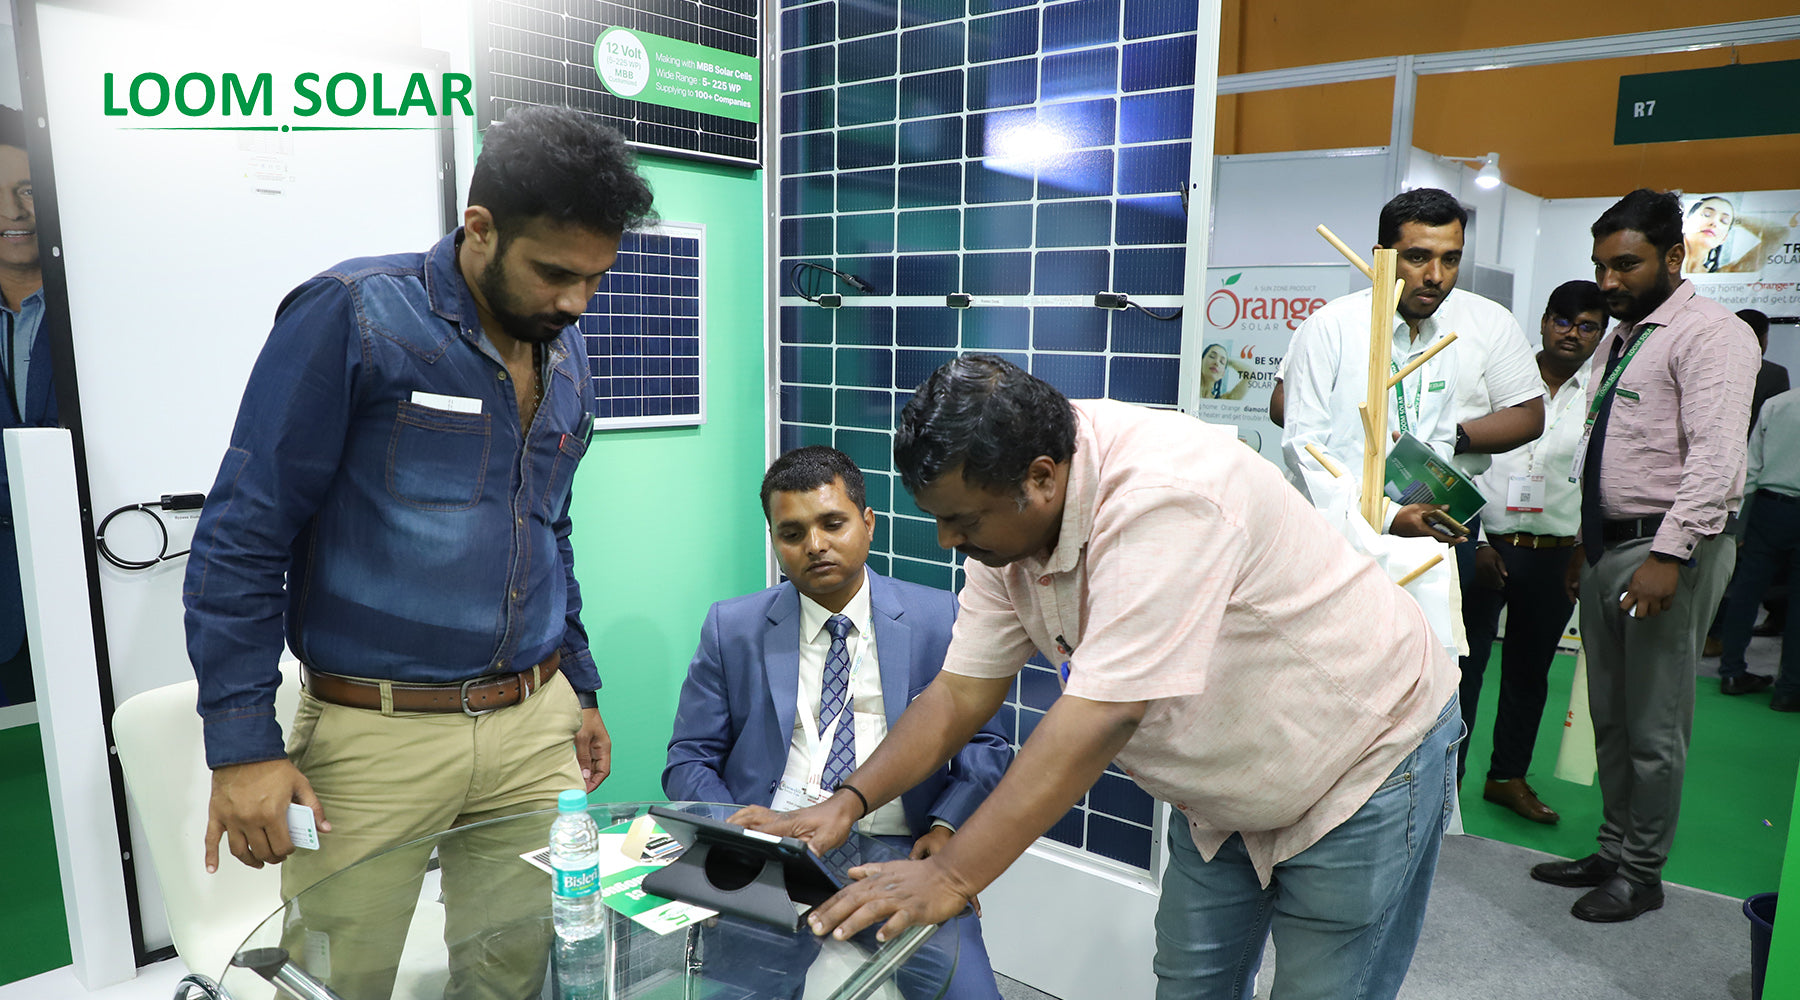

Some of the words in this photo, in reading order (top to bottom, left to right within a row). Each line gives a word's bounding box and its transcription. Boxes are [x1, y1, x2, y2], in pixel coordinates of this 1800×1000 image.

[606, 41, 619, 54] 12
[621, 45, 642, 59] Volt
[656, 52, 681, 67] Making
[681, 60, 696, 69] with
[696, 61, 714, 73] MBB
[715, 65, 734, 77] Solar
[734, 69, 753, 82] Cells
[615, 69, 634, 79] MBB
[656, 67, 675, 80] Wide
[675, 72, 698, 86] Range
[712, 79, 728, 92] 225
[728, 83, 742, 93] WP
[655, 81, 687, 98] Supplying
[687, 89, 695, 97] to
[694, 90, 713, 101] 100+
[713, 93, 752, 109] Companies
[1633, 101, 1656, 117] R7
[1783, 243, 1800, 254] TR
[1767, 255, 1800, 265] SOLA
[1718, 284, 1744, 293] home
[1720, 295, 1748, 304] heater
[1751, 295, 1768, 304] and
[1770, 296, 1786, 306] get
[1241, 322, 1279, 331] SOLAR
[1627, 340, 1642, 357] LOOM
[1254, 356, 1266, 365] BE
[1237, 370, 1277, 381] TRADIT
[1247, 380, 1272, 389] SOLAR
[564, 868, 599, 888] Bisleri
